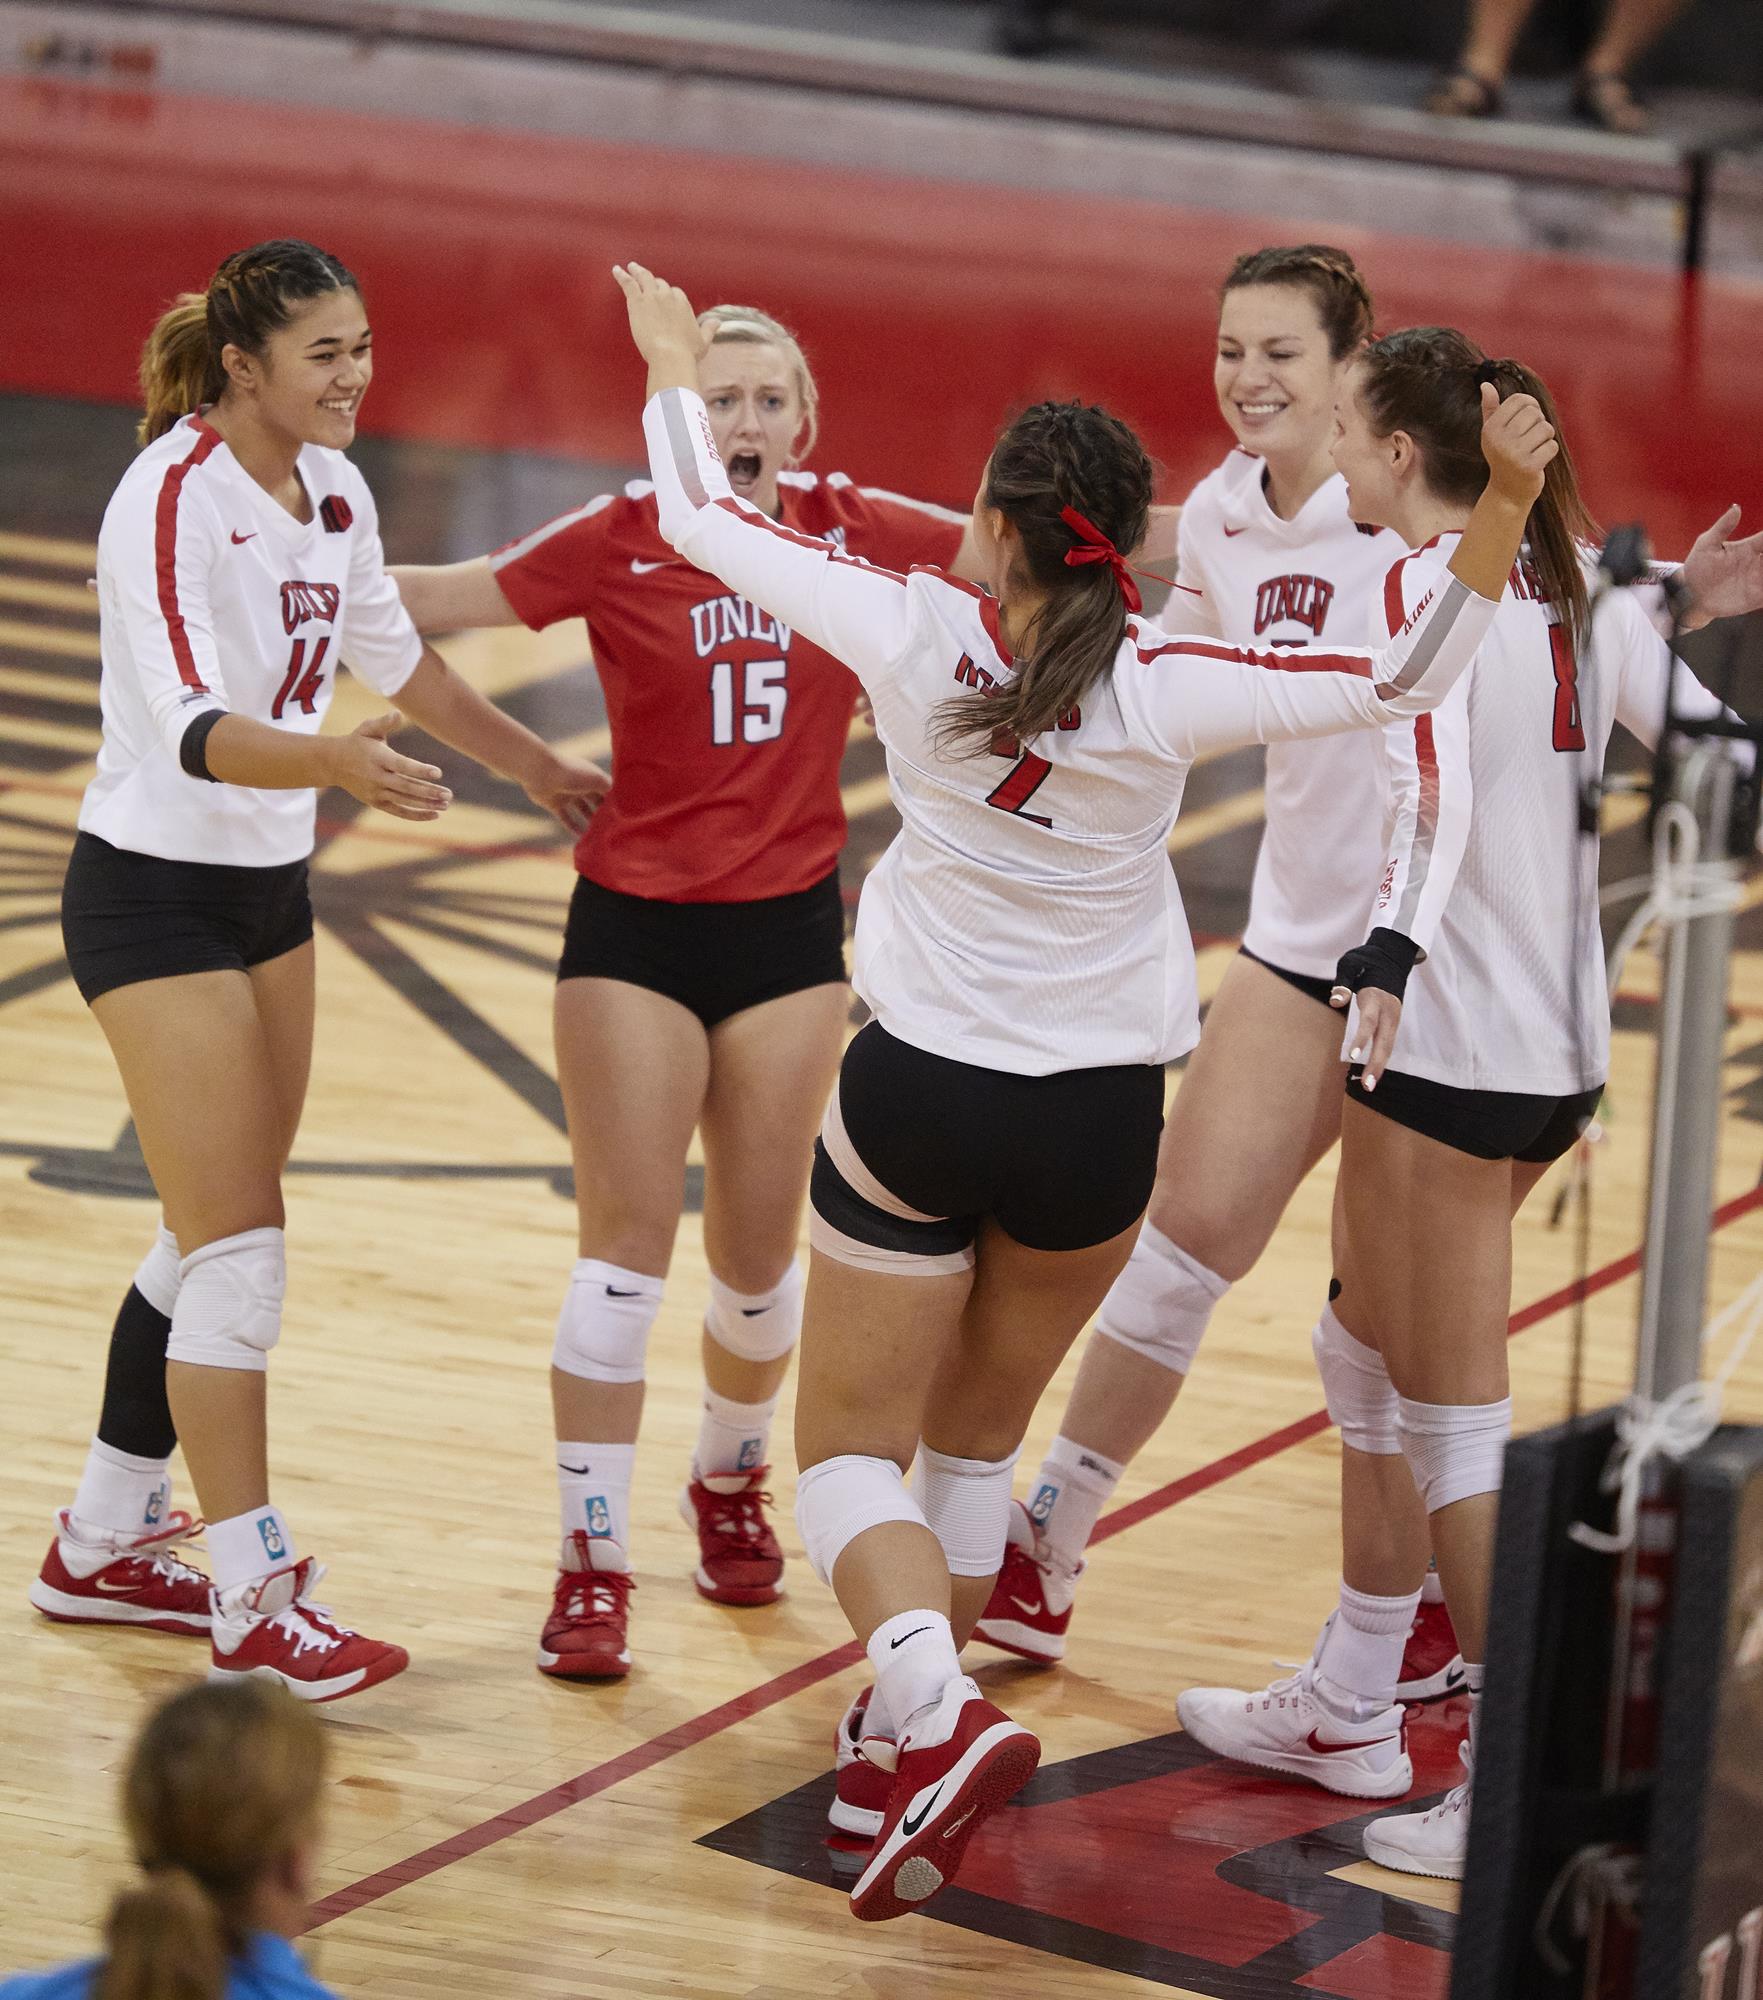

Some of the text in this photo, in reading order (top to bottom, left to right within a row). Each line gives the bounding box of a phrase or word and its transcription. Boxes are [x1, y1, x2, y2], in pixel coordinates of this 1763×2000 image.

[1254, 574, 1334, 636] UNLV
[271, 637, 331, 720] 14
[711, 659, 788, 746] 15
